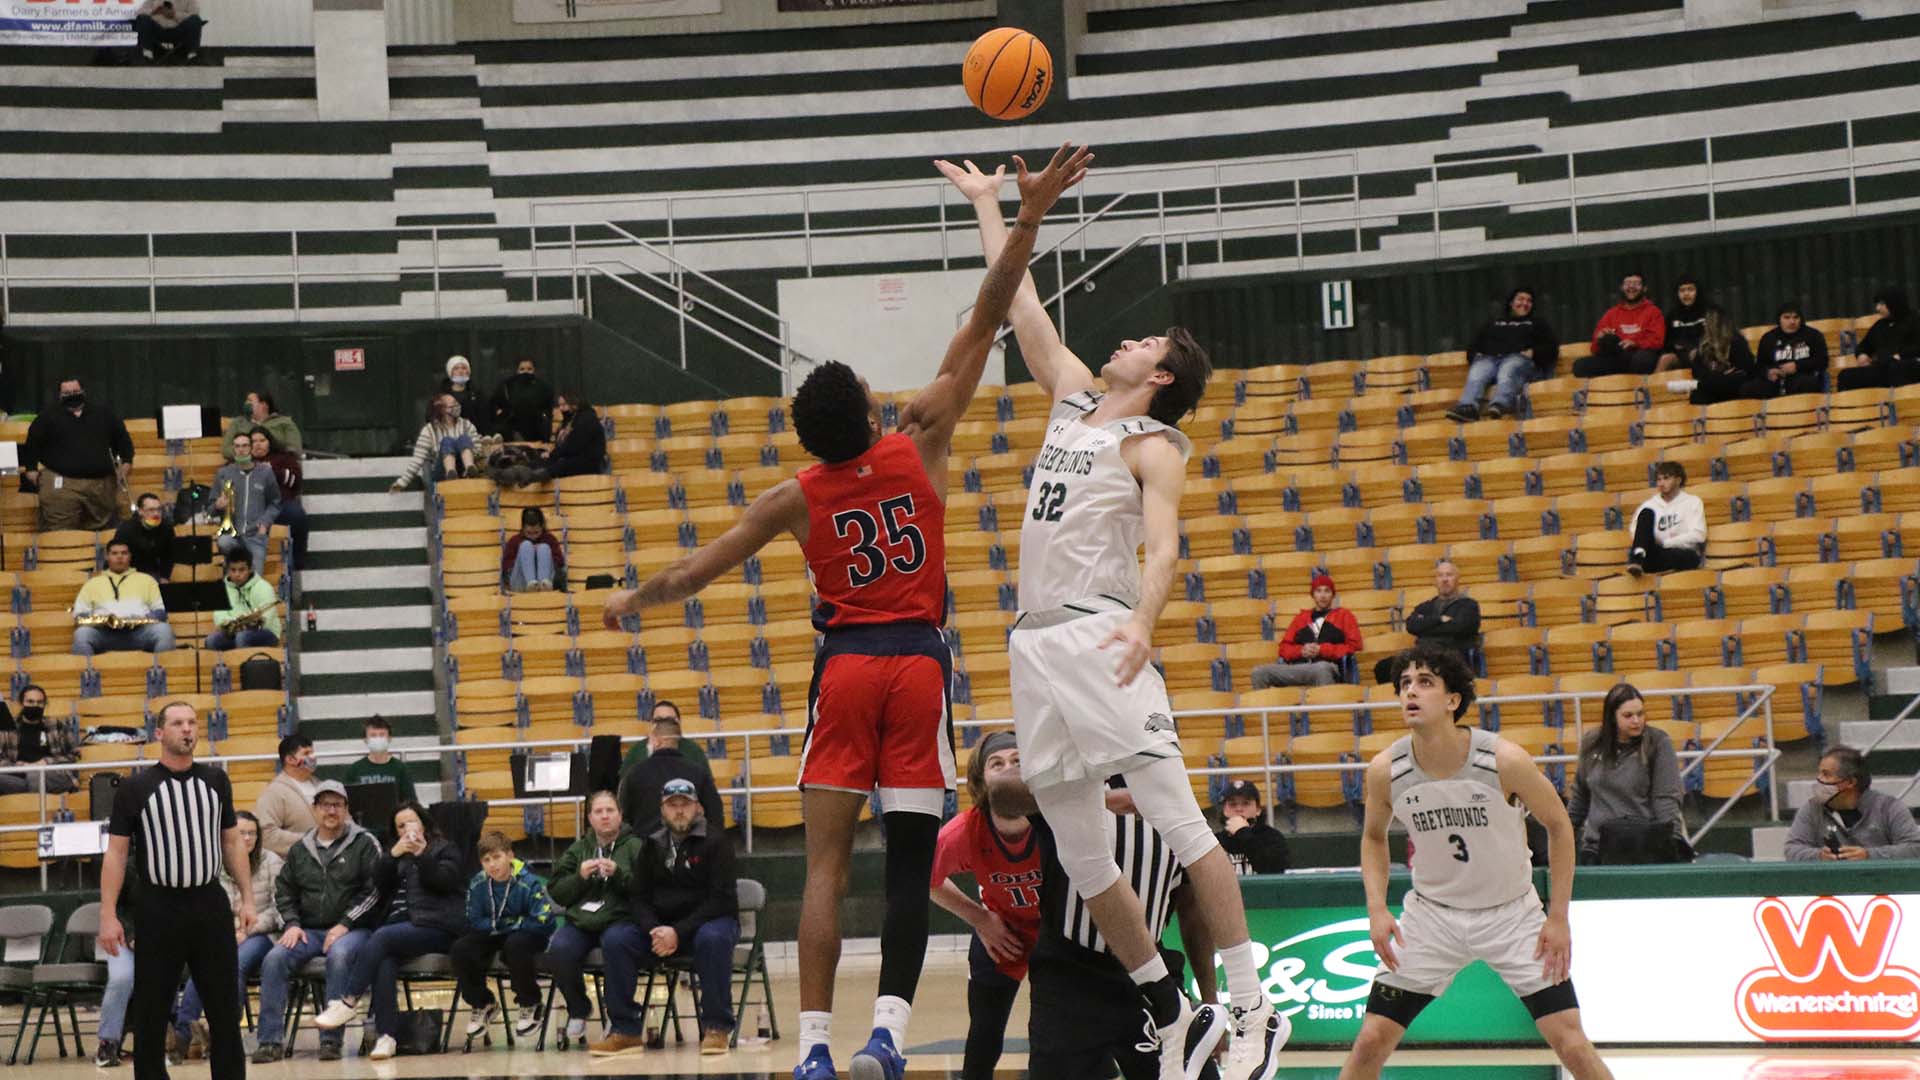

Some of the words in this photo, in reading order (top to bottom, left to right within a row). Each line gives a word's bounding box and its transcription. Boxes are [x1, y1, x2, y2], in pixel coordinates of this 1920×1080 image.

[12, 6, 39, 17] Dairy
[43, 6, 89, 16] Farmers
[92, 6, 103, 16] of
[31, 22, 132, 32] www.dfamilk.com
[1021, 67, 1046, 109] NCAA
[1328, 282, 1347, 326] H
[1032, 481, 1067, 522] 32
[832, 492, 926, 588] 35
[1412, 807, 1489, 832] GREYHOUNDS
[1448, 833, 1470, 863] 3
[1308, 1004, 1353, 1020] Since
[1751, 990, 1919, 1019] Wienerschnitzel
